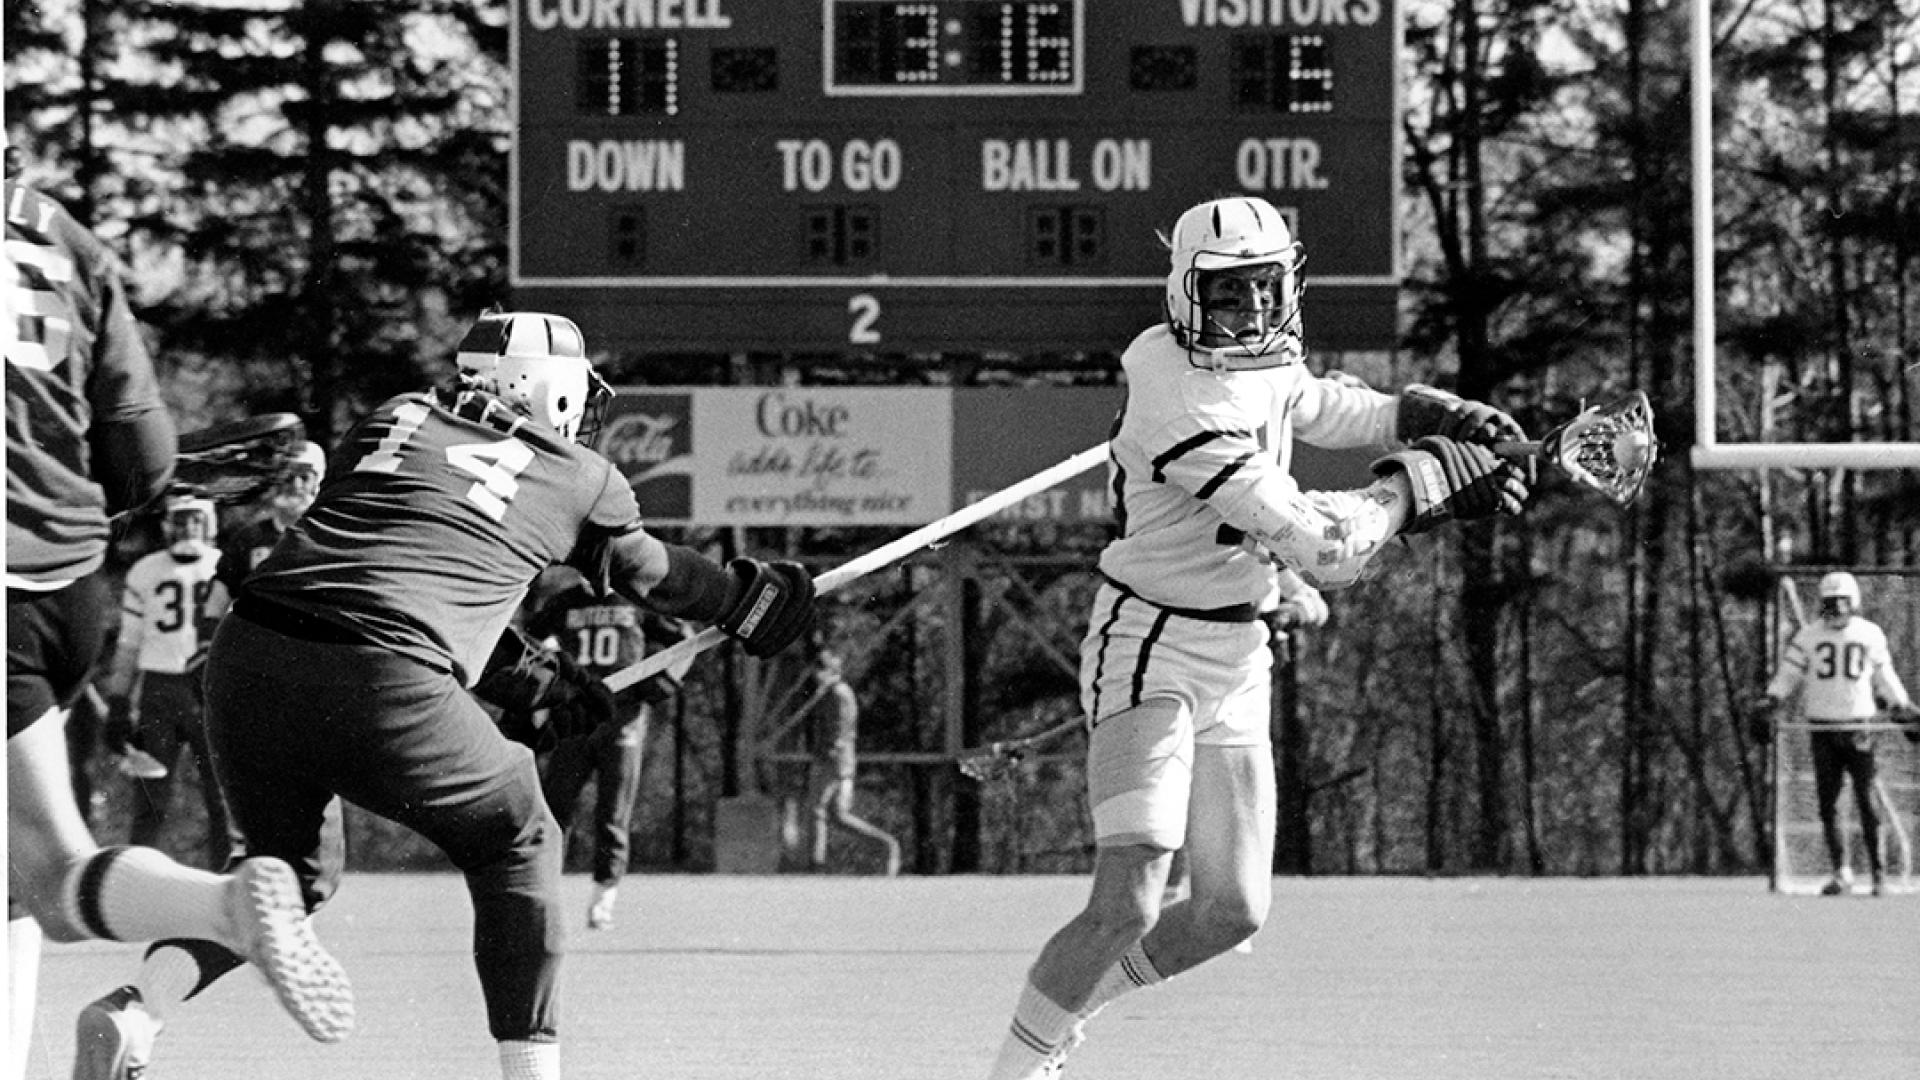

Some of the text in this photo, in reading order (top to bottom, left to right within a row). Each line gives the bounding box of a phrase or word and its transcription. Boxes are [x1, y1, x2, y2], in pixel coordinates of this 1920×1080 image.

[527, 0, 733, 30] CORNELL
[1179, 0, 1382, 27] VISITORS
[608, 38, 679, 116] 11
[567, 139, 685, 192] DOWN
[776, 139, 901, 192] TO GO
[982, 139, 1151, 191] BALL ON
[1236, 138, 1329, 190] QTR.
[848, 294, 881, 344] 2
[756, 391, 849, 438] Coke
[352, 401, 536, 522] 14
[577, 627, 620, 666] 10
[1815, 642, 1864, 680] 30
